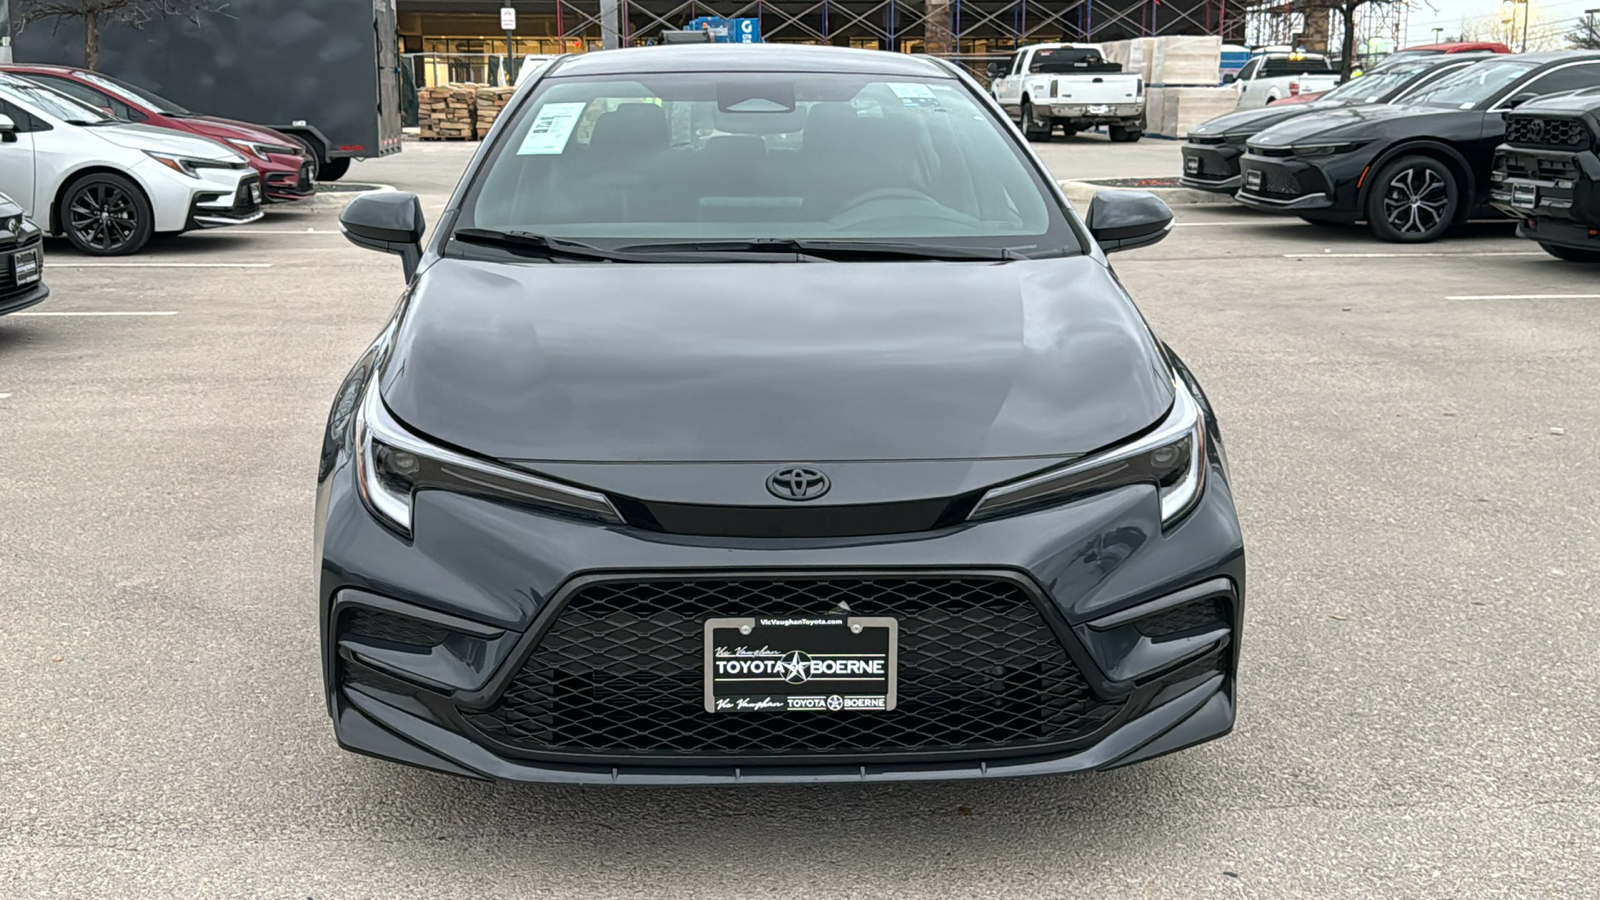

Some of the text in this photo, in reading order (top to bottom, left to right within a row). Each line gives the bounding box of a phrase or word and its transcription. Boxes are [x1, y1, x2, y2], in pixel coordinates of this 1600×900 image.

[760, 618, 843, 627] VicVaughanToyota.com
[715, 645, 781, 658] Vic Vaughan
[716, 660, 785, 674] TOYOTA
[810, 660, 885, 674] BOERNE
[716, 697, 733, 710] Vic
[736, 697, 784, 710] Vaughan
[787, 699, 826, 708] TOYOTA
[844, 698, 885, 707] BOERNE
